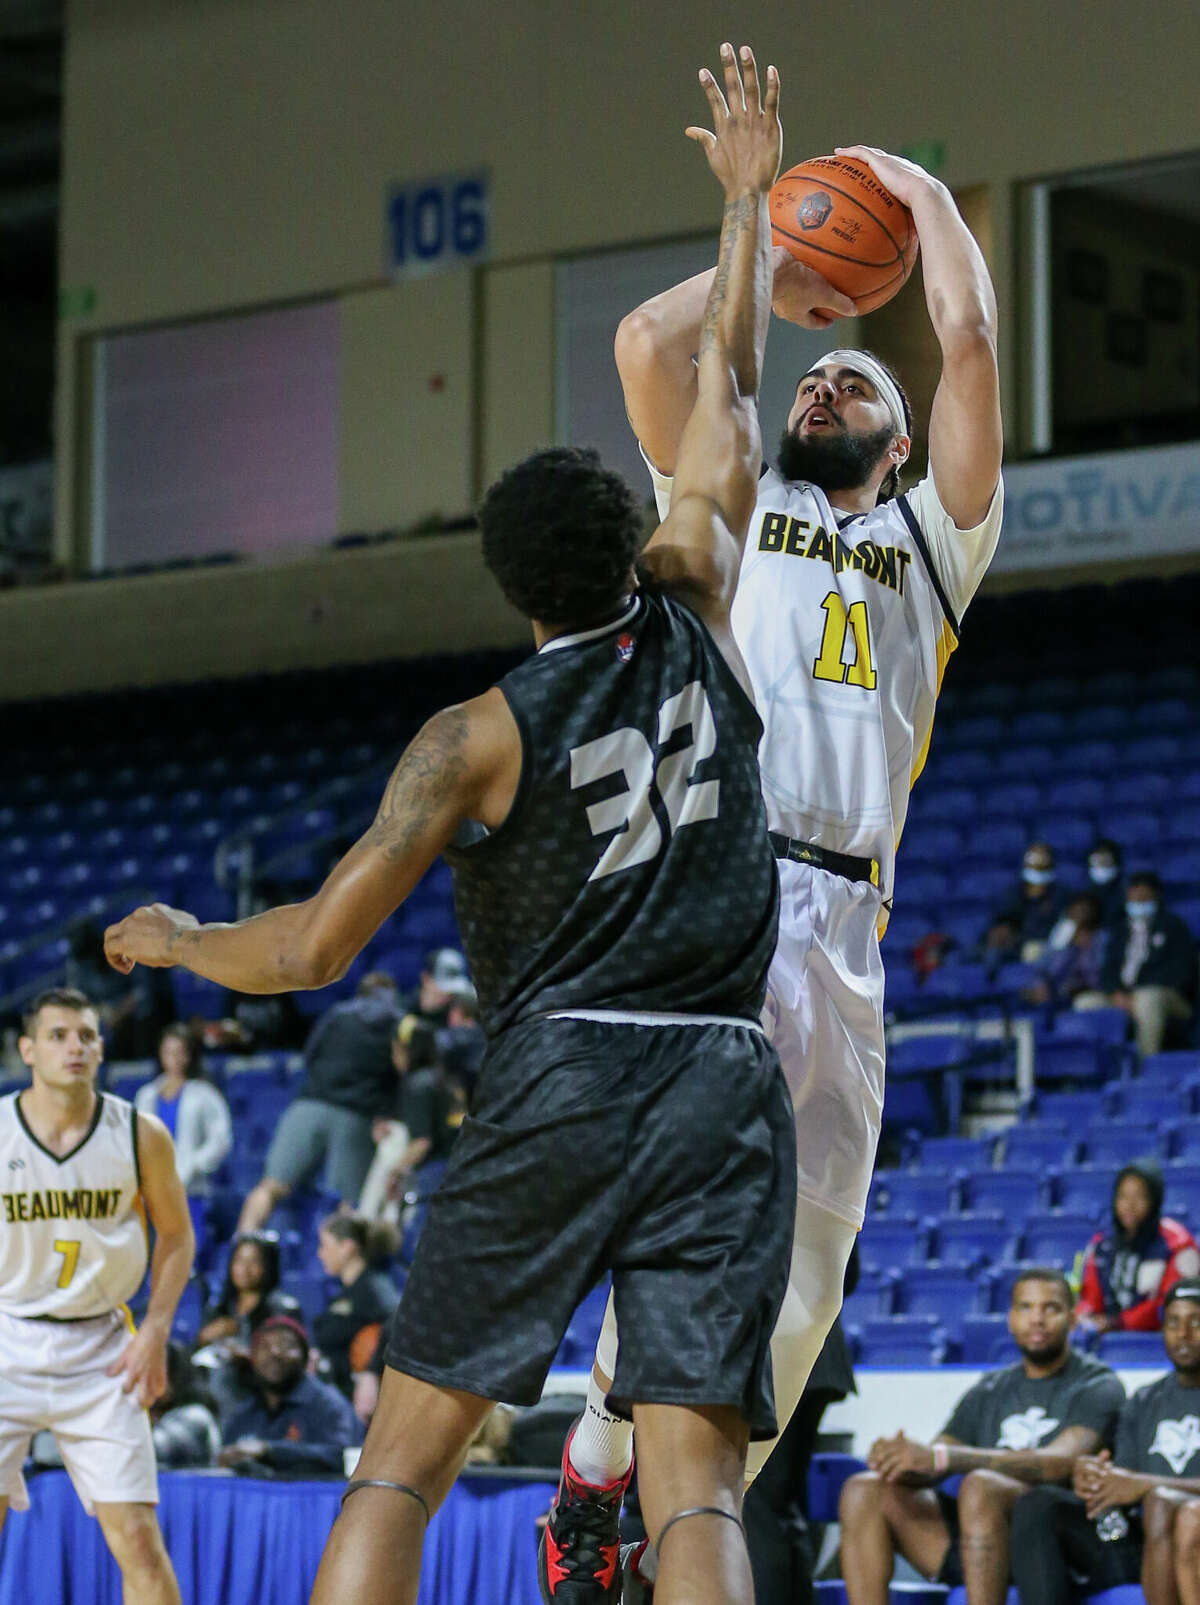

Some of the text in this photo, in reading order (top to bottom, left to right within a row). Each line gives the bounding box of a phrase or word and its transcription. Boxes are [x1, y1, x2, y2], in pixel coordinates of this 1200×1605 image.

[388, 181, 485, 265] 106
[812, 591, 877, 690] 11
[569, 680, 720, 882] 32
[54, 1239, 81, 1289] 7
